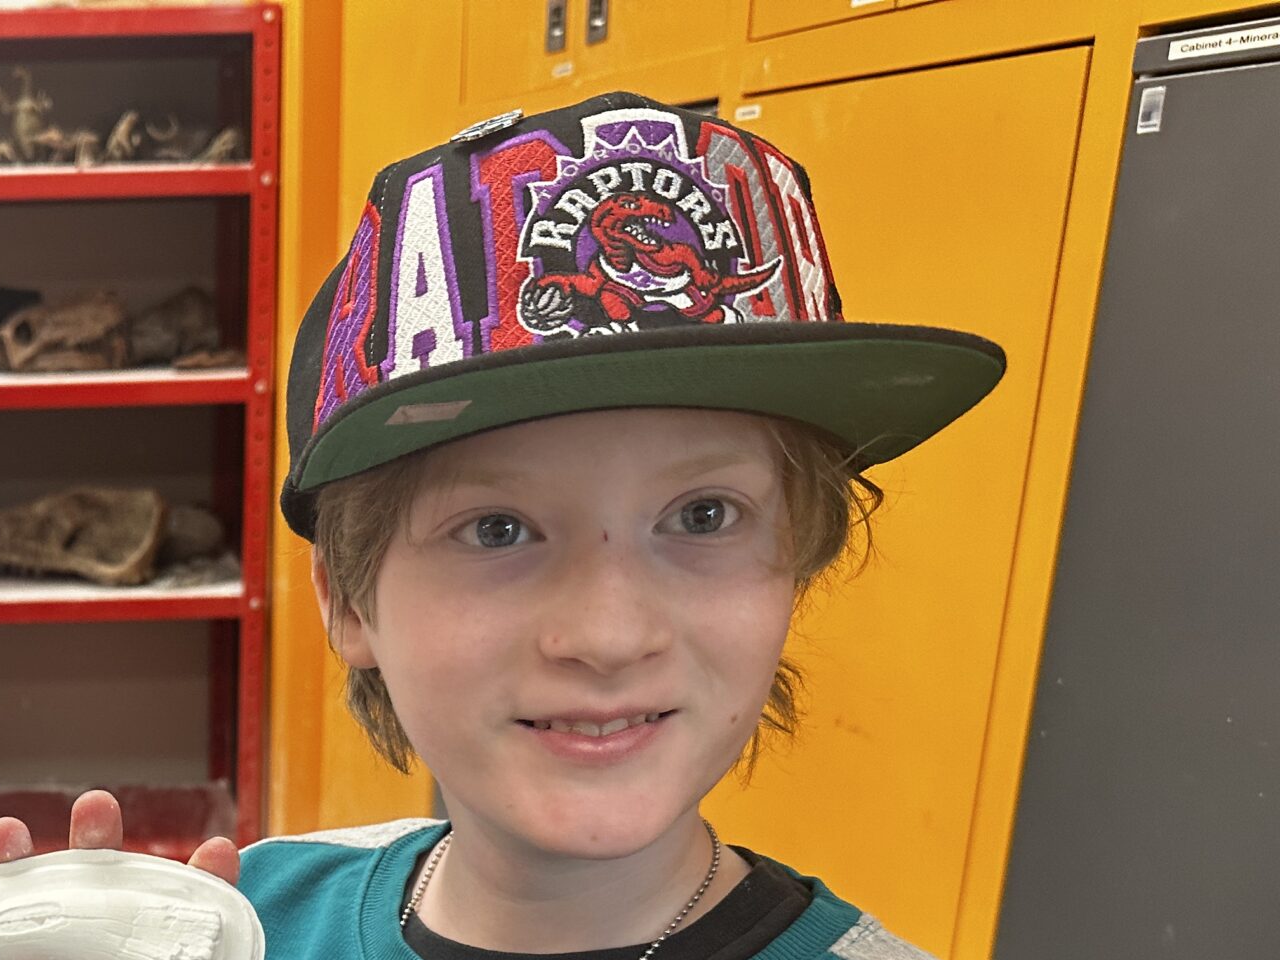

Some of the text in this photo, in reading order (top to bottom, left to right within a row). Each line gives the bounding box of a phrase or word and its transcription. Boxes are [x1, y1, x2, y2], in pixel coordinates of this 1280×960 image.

[1180, 31, 1280, 53] Cabinet 4-Minera
[536, 142, 724, 204] TORONTO
[528, 161, 738, 252] RAPTORS
